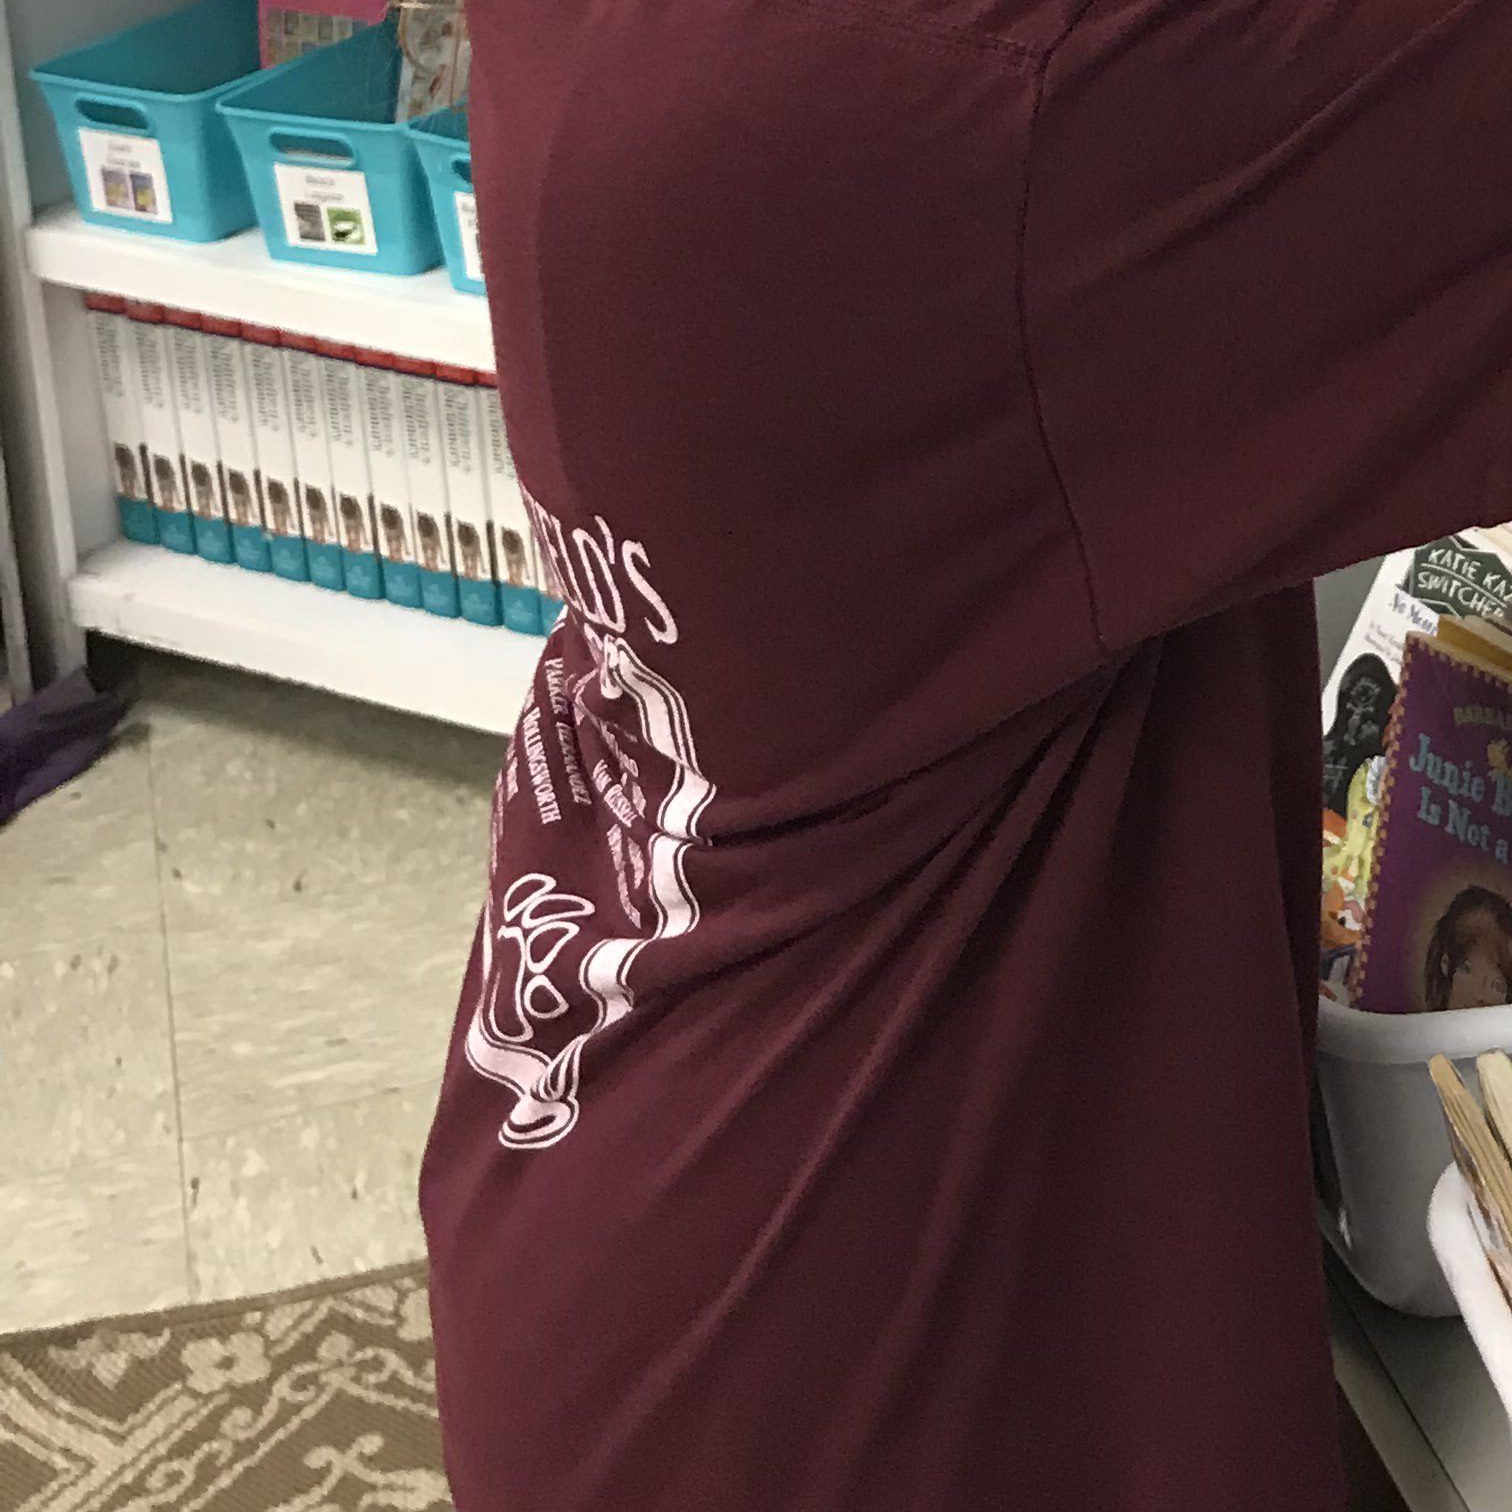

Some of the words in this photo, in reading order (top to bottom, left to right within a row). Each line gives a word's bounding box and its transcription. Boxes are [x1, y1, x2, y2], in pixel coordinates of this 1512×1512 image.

[1428, 548, 1481, 579] KATIE
[1409, 732, 1485, 803] Junie
[1418, 786, 1442, 825] Is
[1445, 799, 1491, 851] Not
[1495, 839, 1508, 865] a
